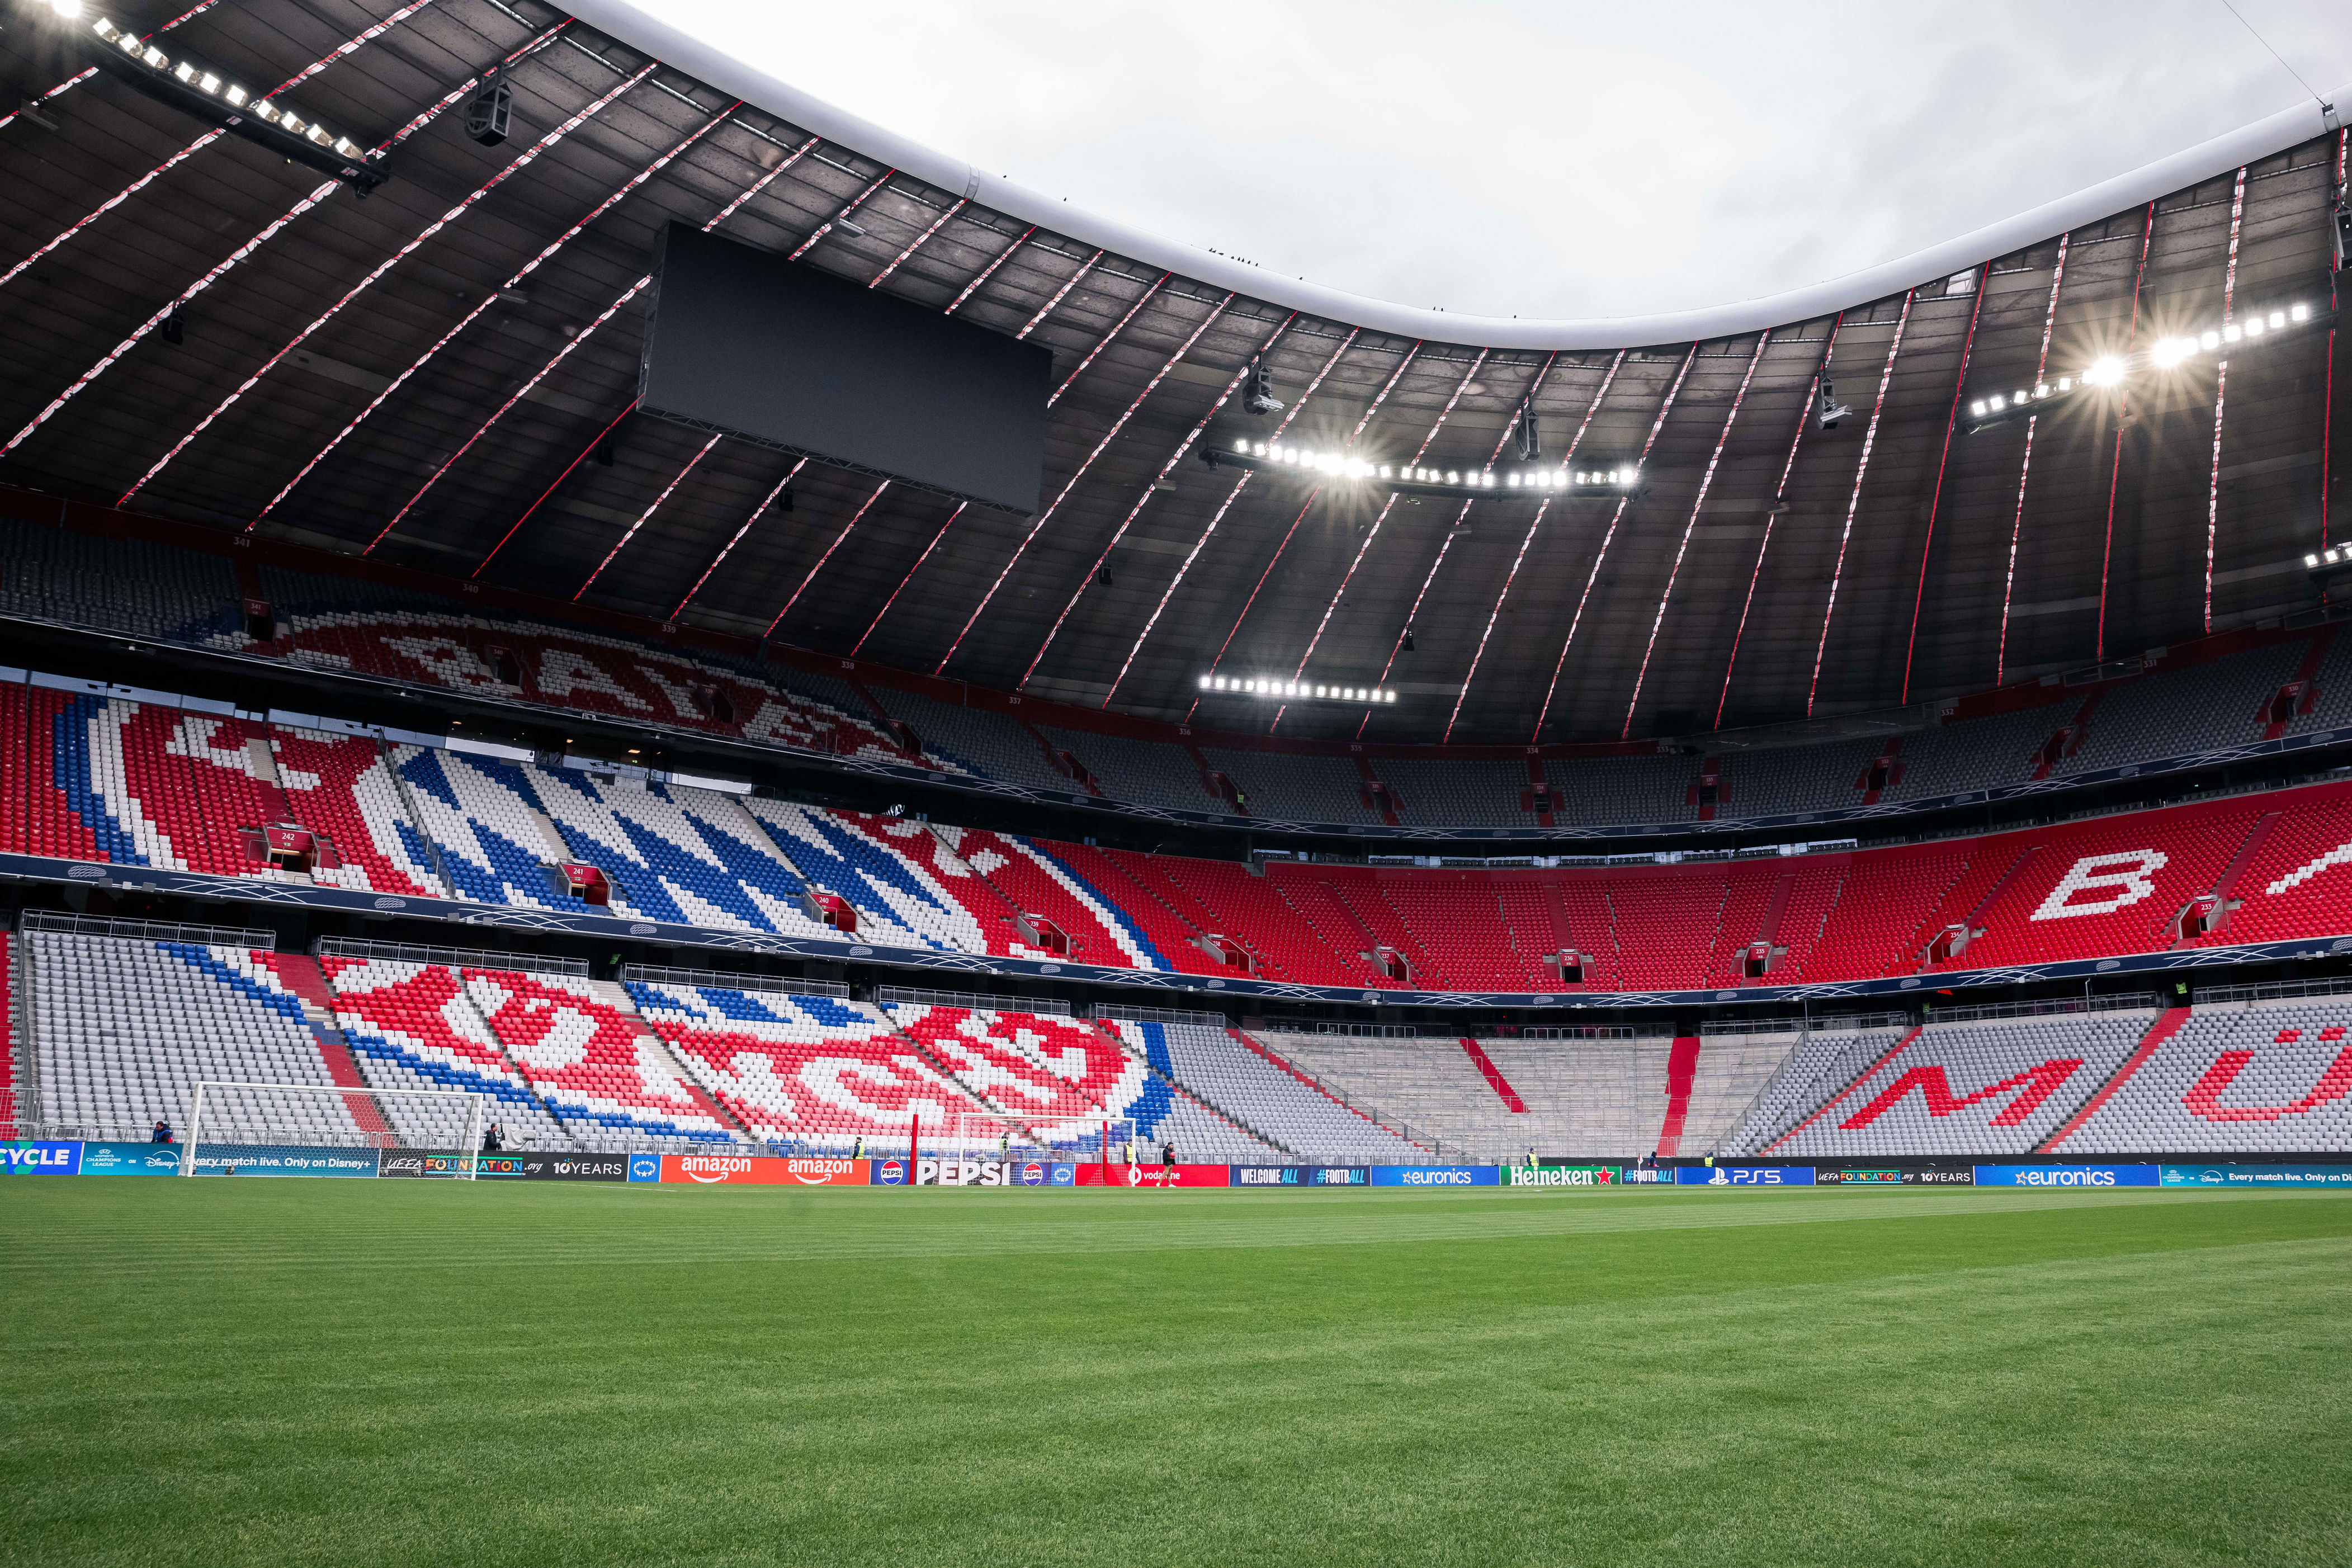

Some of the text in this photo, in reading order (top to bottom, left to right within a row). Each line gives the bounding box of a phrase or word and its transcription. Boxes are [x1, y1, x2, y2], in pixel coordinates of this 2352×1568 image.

[234, 536, 250, 547] 341
[462, 583, 479, 593] 340
[662, 624, 676, 633] 339
[841, 660, 854, 670] 338
[221, 1158, 257, 1166] match
[260, 1157, 281, 1166] live.
[285, 1158, 309, 1168] Only
[328, 1159, 370, 1169] Disney+
[387, 1159, 423, 1169] UEFA
[572, 1163, 622, 1174] YEARS
[681, 1157, 751, 1172] amazon
[788, 1159, 853, 1173] amazon
[918, 1161, 1010, 1185] PEPSI
[1144, 1170, 1180, 1180] vodane
[1316, 1169, 1364, 1184] #FOOTBALL
[1411, 1168, 1471, 1184] euronics
[1510, 1166, 1594, 1186] Heineken
[1624, 1169, 1673, 1182] #FOOTBALL
[1734, 1170, 1781, 1183] PS5
[1933, 1173, 1971, 1182] YEARS
[2028, 1167, 2115, 1186] euronics
[2229, 1173, 2252, 1182] Every
[2305, 1174, 2326, 1183] Only
